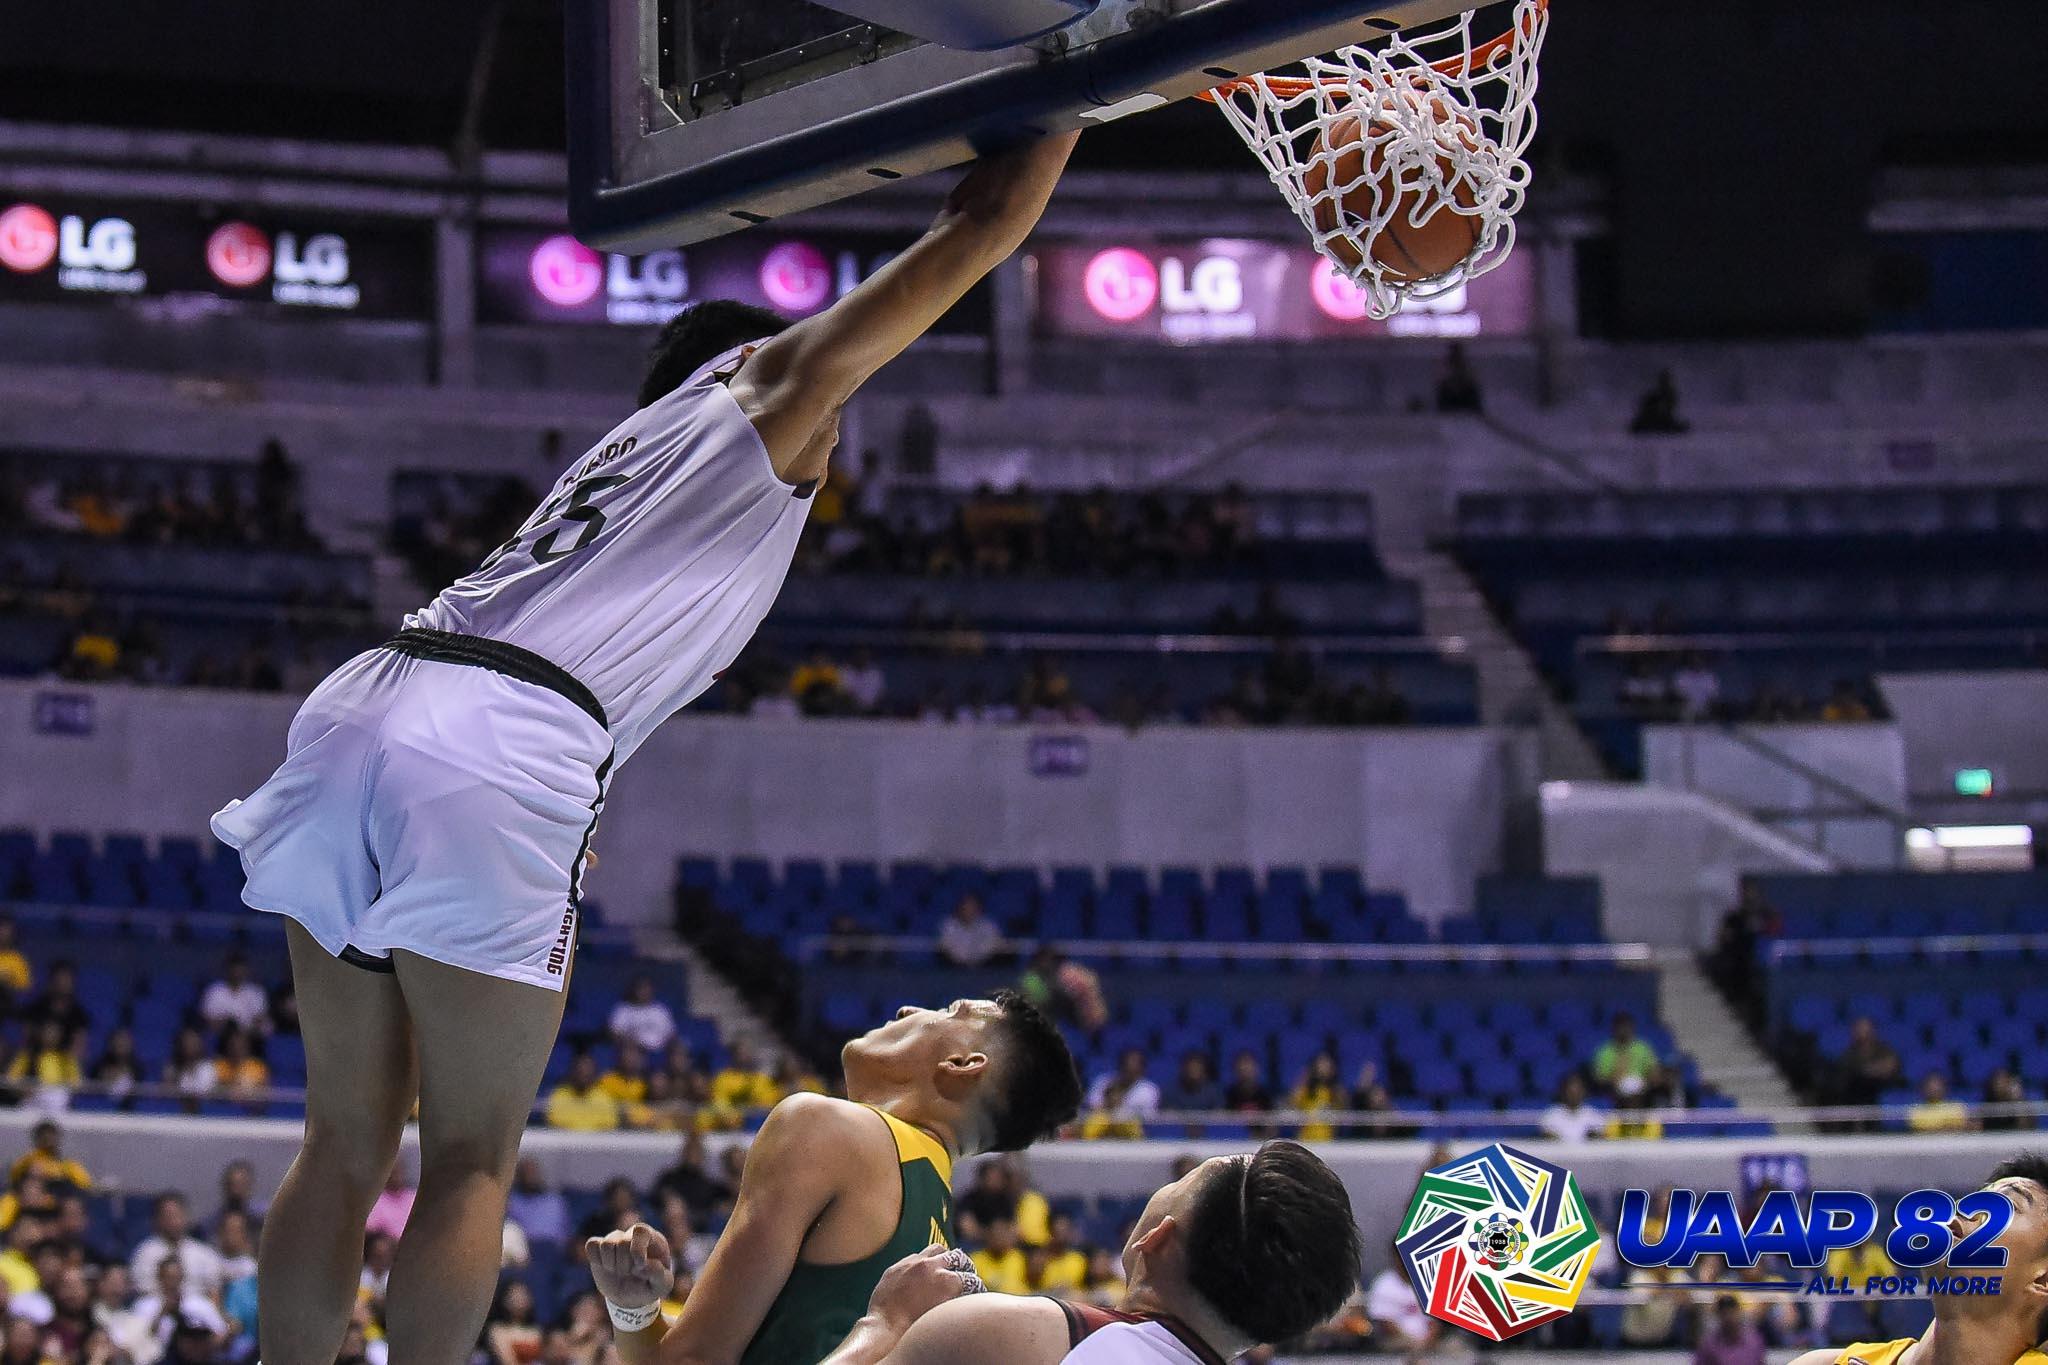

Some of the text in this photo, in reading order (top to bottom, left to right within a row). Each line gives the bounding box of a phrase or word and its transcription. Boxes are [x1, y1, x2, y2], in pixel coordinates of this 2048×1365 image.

[59, 214, 137, 271] LG
[273, 230, 350, 286] LG
[606, 250, 688, 302] LG
[1160, 255, 1243, 313] LG
